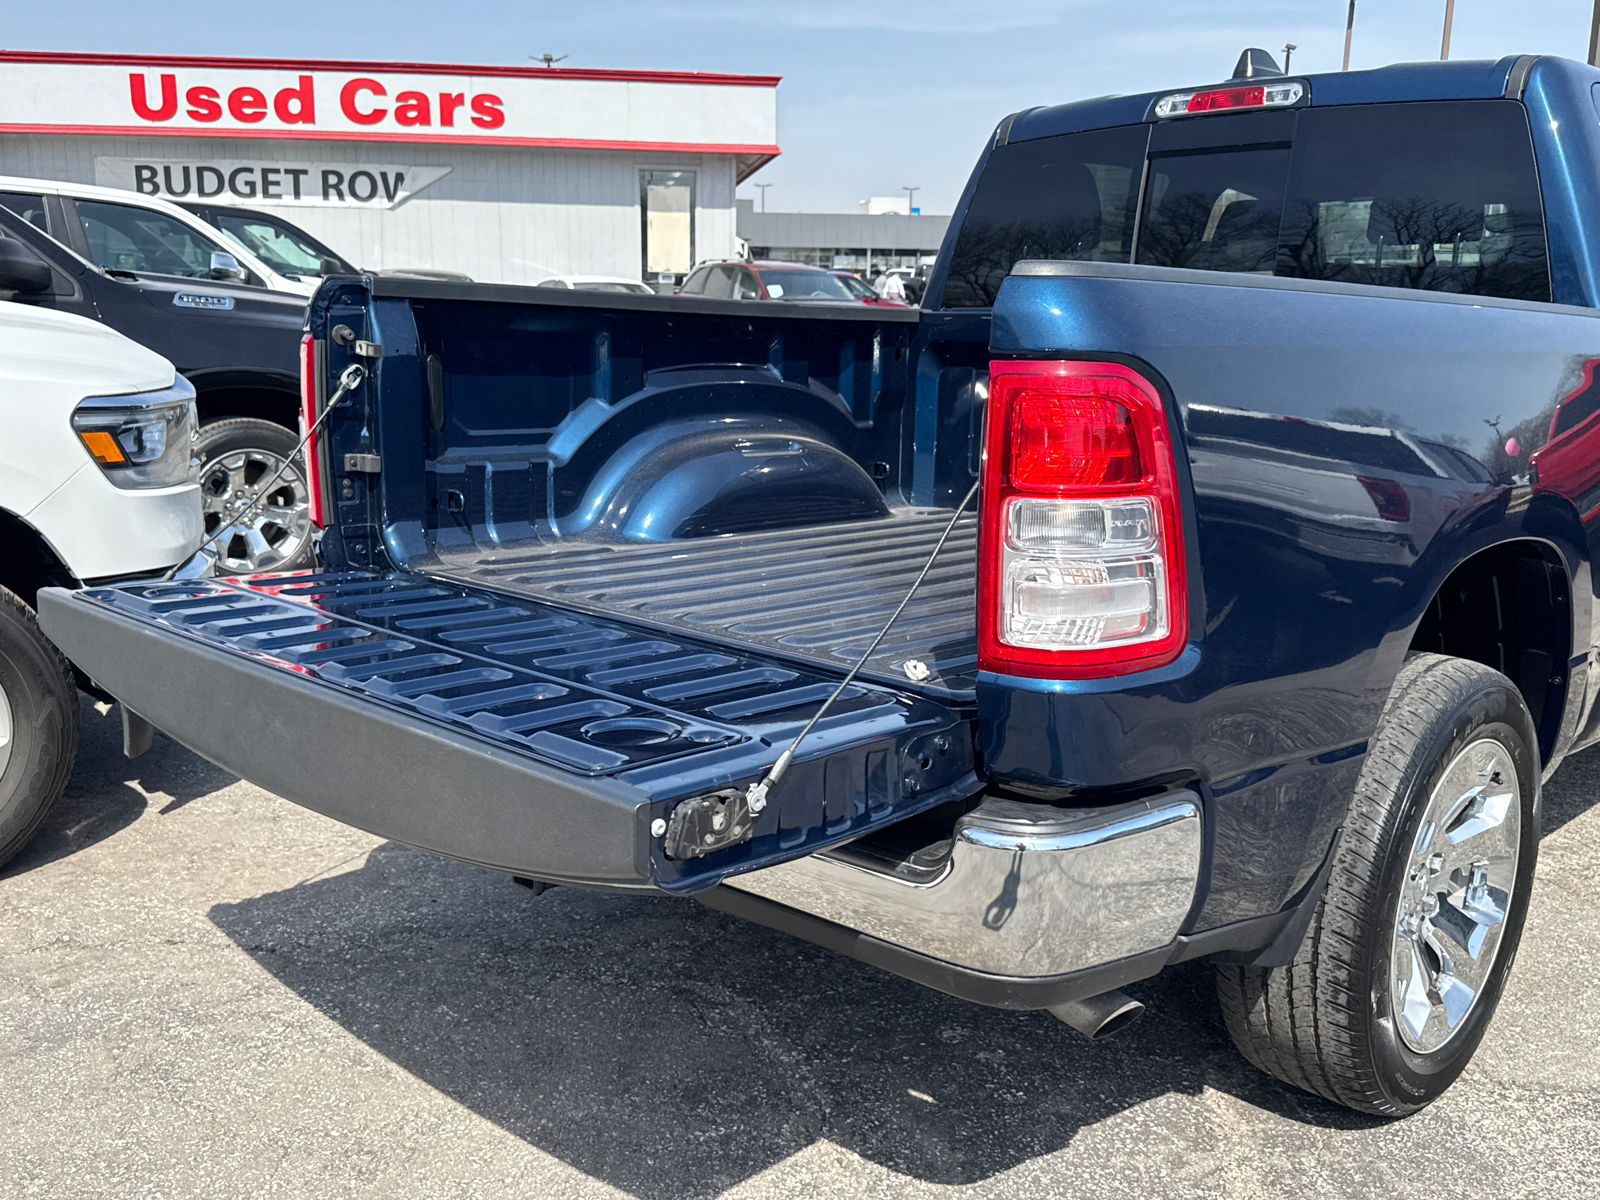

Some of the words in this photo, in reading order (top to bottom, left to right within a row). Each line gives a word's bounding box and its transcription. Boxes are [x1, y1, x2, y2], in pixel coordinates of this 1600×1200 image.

[129, 73, 315, 124] Used
[340, 77, 505, 129] Cars
[134, 165, 309, 200] BUDGET
